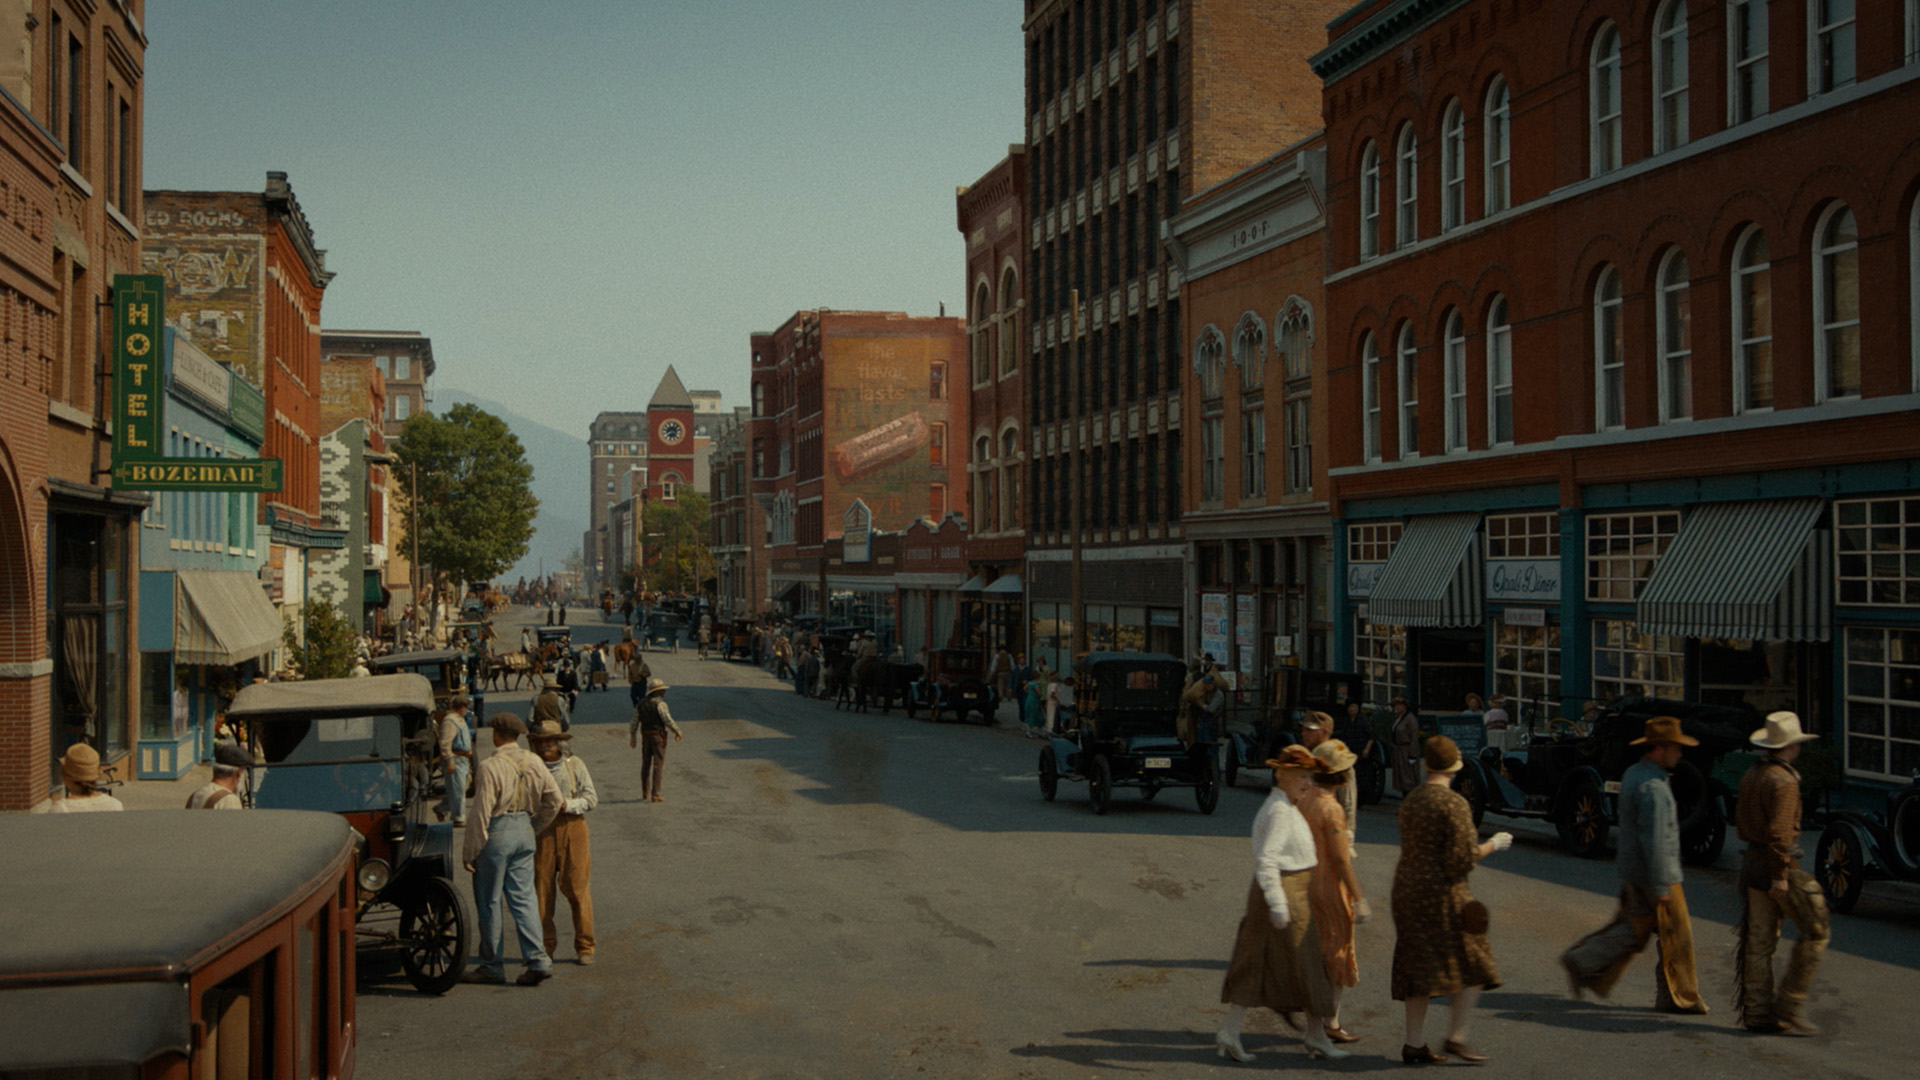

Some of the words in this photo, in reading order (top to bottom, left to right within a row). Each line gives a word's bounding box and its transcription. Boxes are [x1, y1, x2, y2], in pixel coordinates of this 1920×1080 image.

[126, 303, 151, 447] HOTEL
[859, 382, 905, 401] lasts
[132, 465, 255, 482] BOZEMAN
[1522, 563, 1558, 593] Diner
